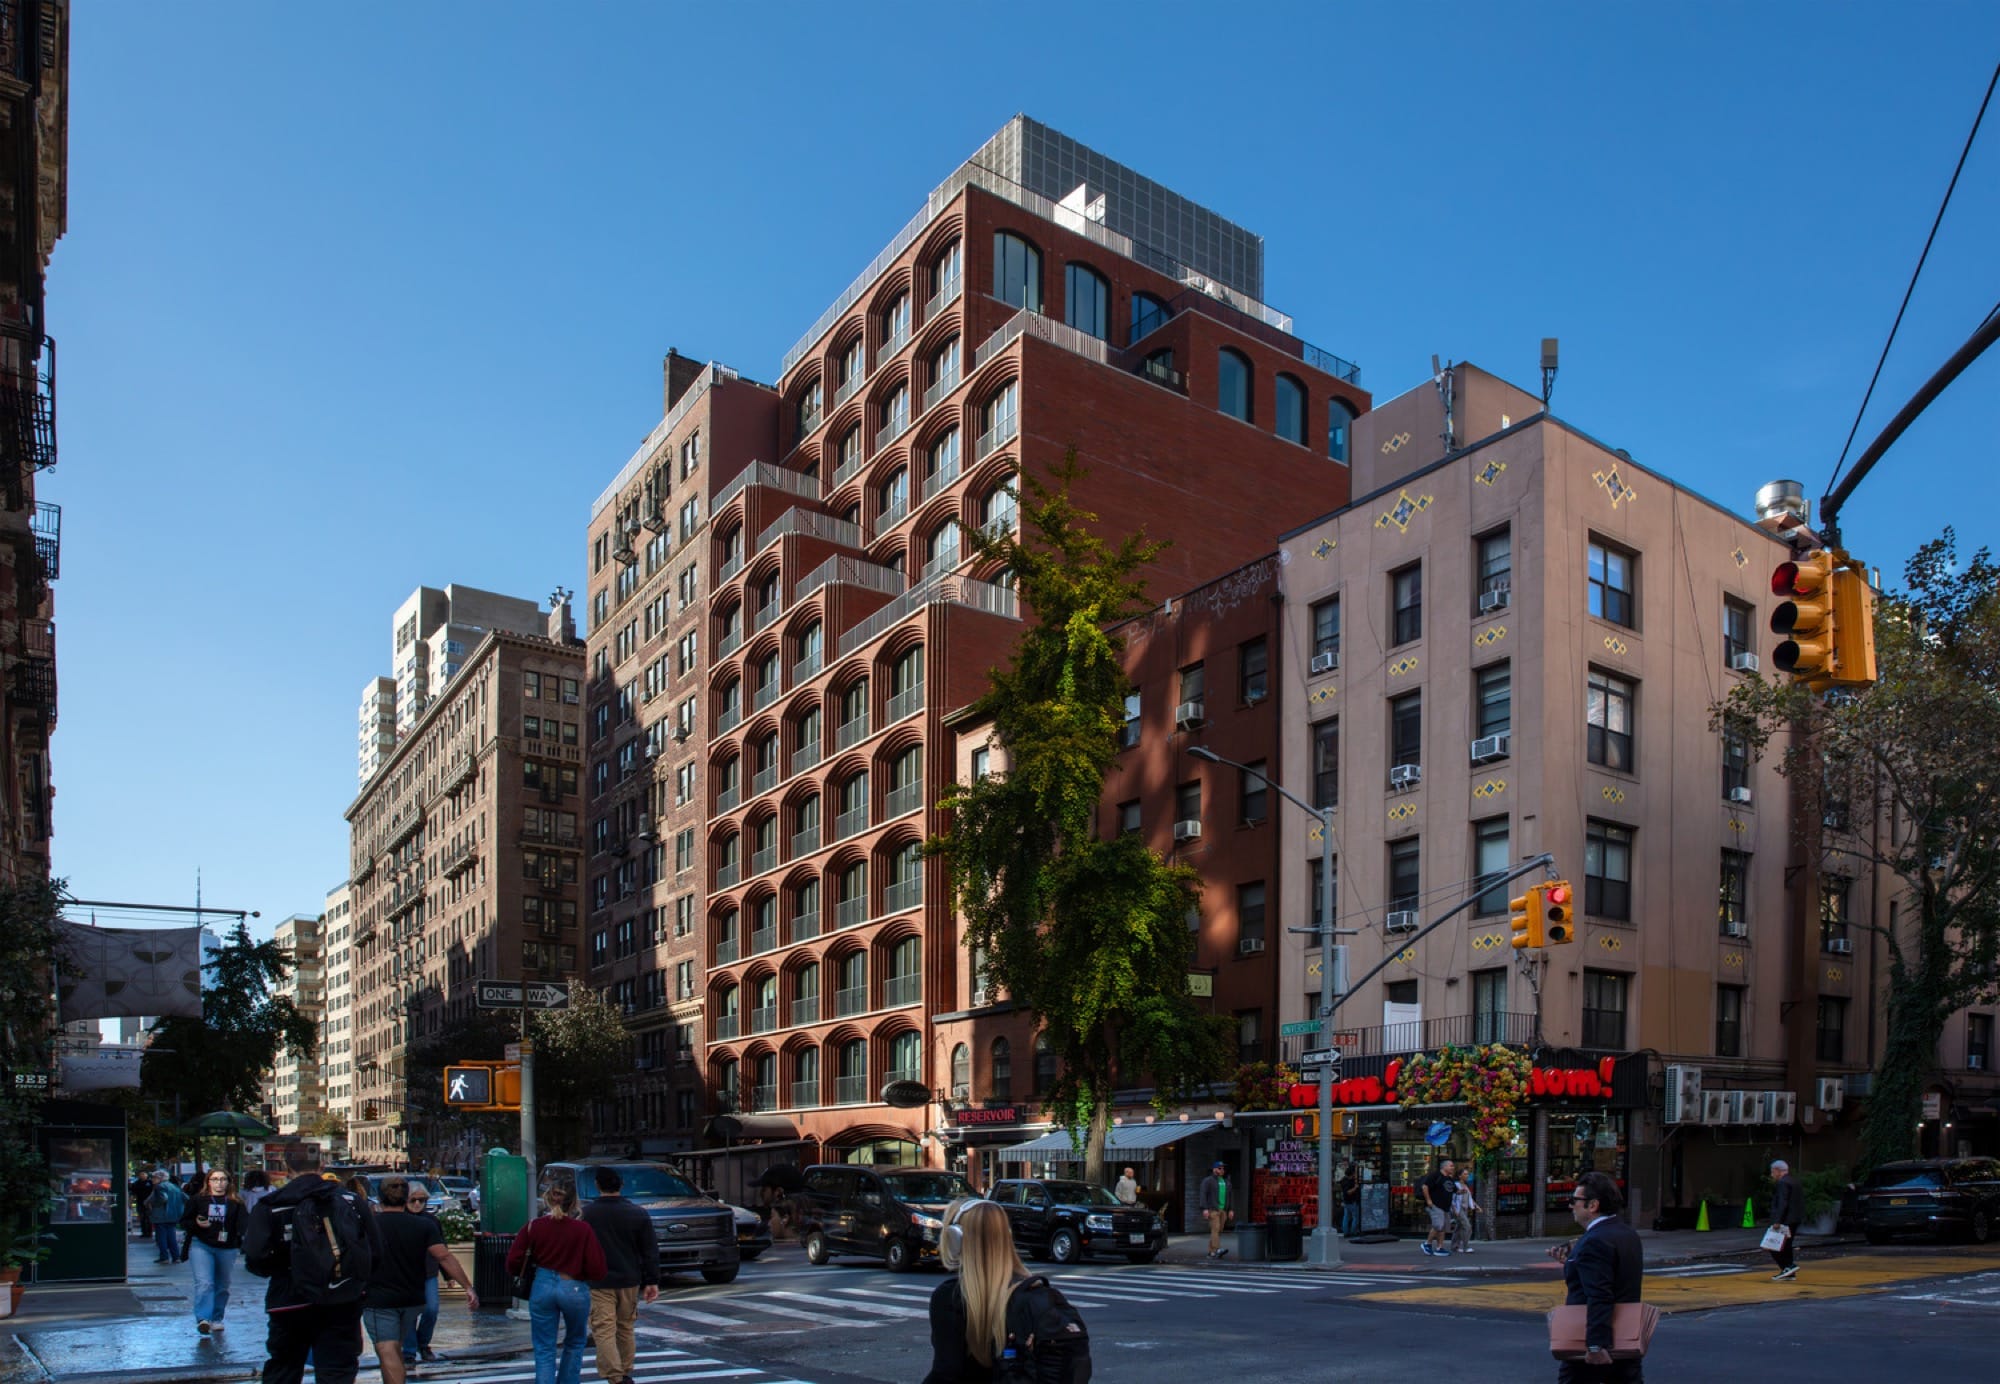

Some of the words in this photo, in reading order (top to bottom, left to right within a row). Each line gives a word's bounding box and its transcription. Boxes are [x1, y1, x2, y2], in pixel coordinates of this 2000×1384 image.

[486, 988, 513, 1000] ONE
[528, 990, 557, 1001] WAY
[1283, 1022, 1314, 1034] UNIVERSITY
[1323, 1052, 1336, 1061] WAY
[15, 1074, 48, 1084] SEE
[958, 1108, 1016, 1123] RESERVOIR
